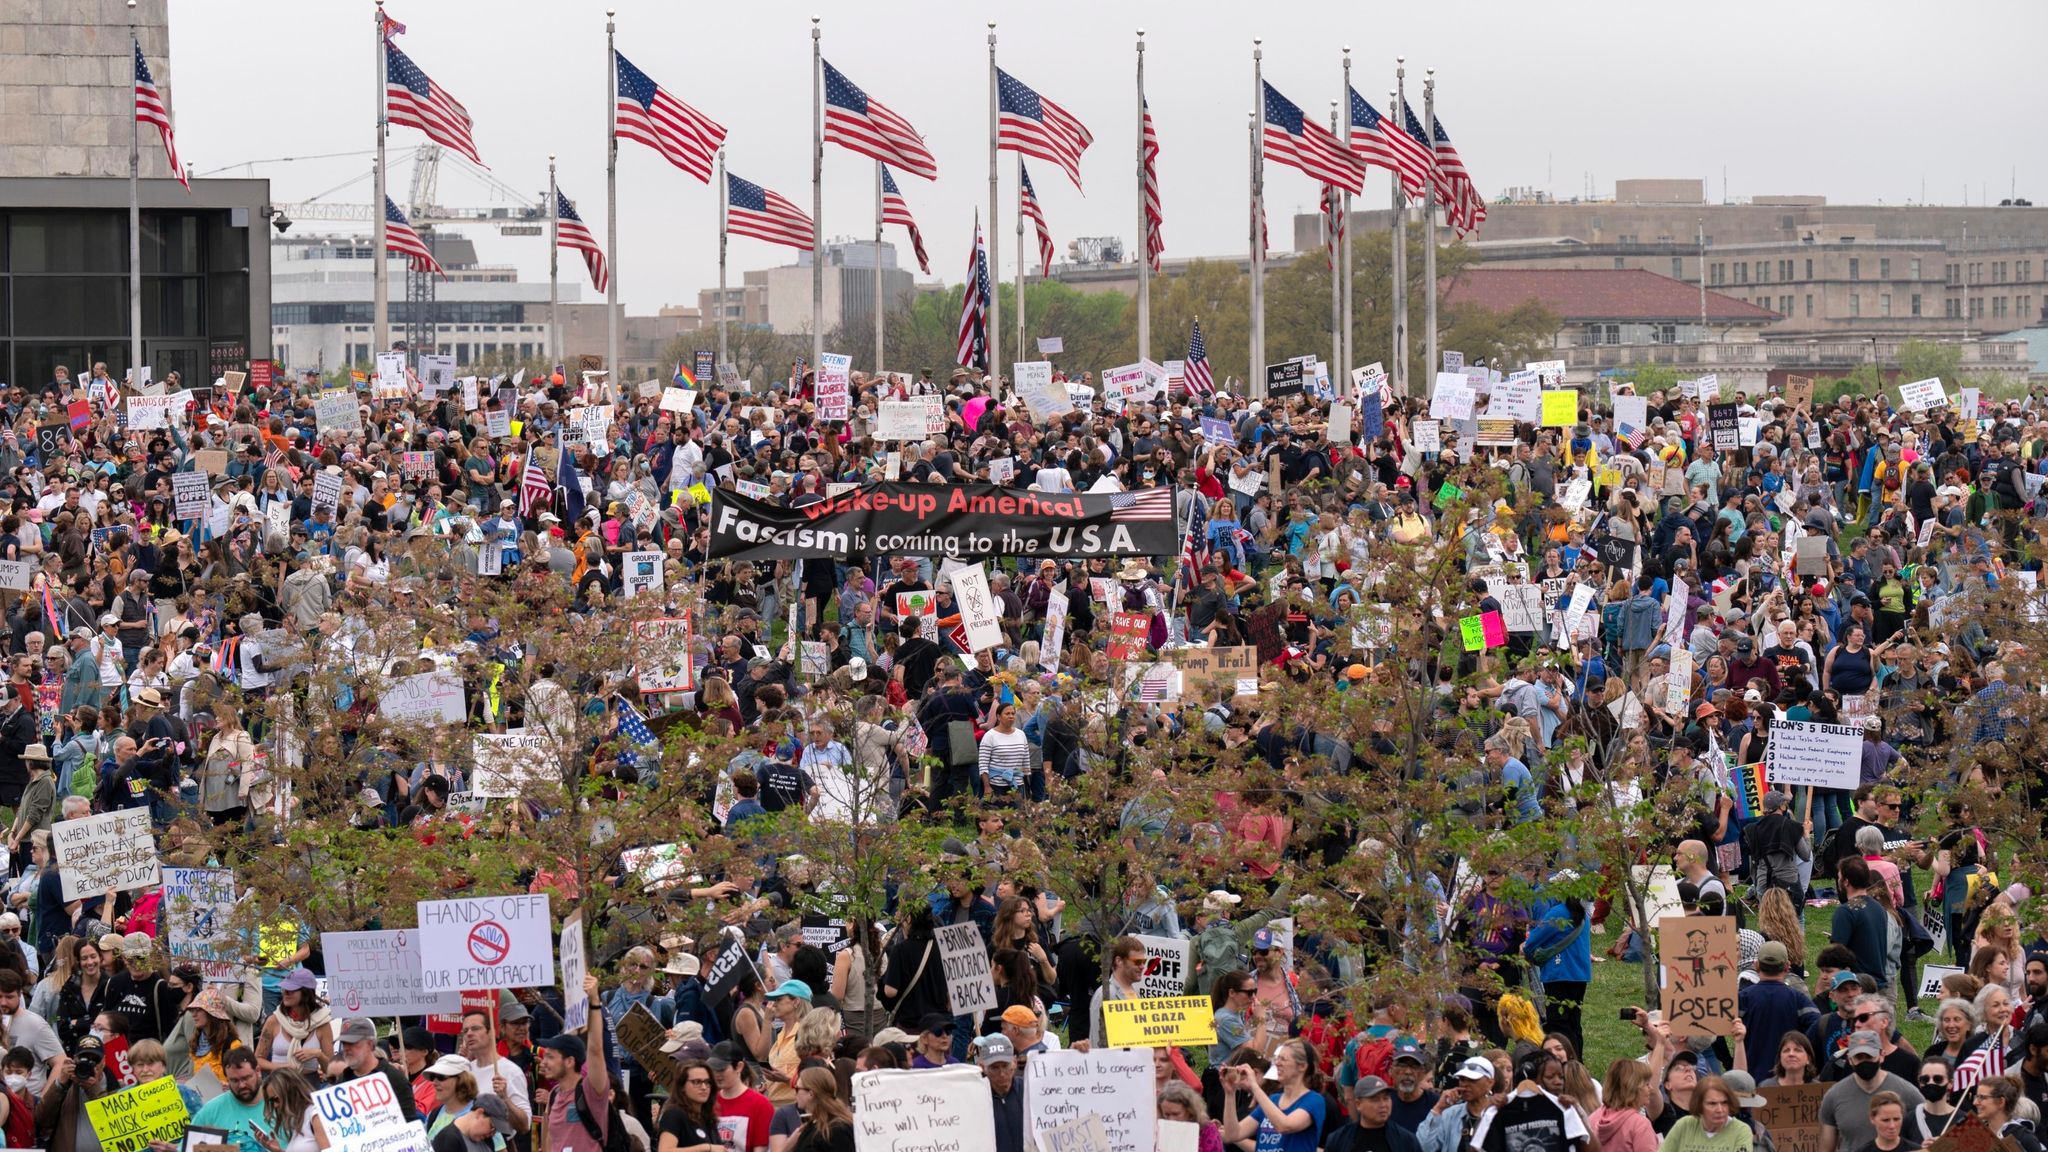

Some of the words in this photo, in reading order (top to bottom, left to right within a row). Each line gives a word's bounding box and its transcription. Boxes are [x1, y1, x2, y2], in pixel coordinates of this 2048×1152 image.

[1362, 368, 1375, 377] NO
[129, 398, 157, 407] HANDS
[159, 397, 175, 406] OFF
[1924, 398, 1945, 408] STUFF
[1713, 408, 1733, 417] 8647
[1716, 419, 1733, 428] MUSK
[1717, 434, 1734, 443] OFF!
[404, 452, 434, 462] RESIST
[178, 485, 205, 494] HANDS
[316, 484, 338, 495] HANDS
[179, 492, 207, 502] OFF!
[316, 492, 337, 504] OFF!
[802, 485, 937, 520] Wake-up
[948, 487, 1085, 517] America!
[716, 504, 848, 554] Fascism
[854, 528, 866, 551] is
[875, 528, 960, 556] coming
[968, 532, 992, 553] to
[1001, 528, 1038, 554] the
[1049, 524, 1142, 554] U.S.A.
[962, 574, 978, 588] NOT
[974, 612, 984, 621] MY
[1115, 616, 1130, 627] SAVE
[1133, 618, 1146, 629] OUR
[970, 619, 993, 631] PRESIDENT
[1211, 648, 1250, 668] Trail
[401, 700, 443, 709] SCIENCE
[1769, 720, 1804, 731] ELON'S
[1810, 724, 1815, 732] 5
[1821, 725, 1864, 736] BULLETS
[1769, 742, 1775, 750] 2
[1769, 752, 1775, 760] 3
[1769, 773, 1774, 781] 5
[1781, 774, 1800, 782] Kissed
[1814, 777, 1828, 785] ring
[1742, 768, 1761, 812] RESIST
[451, 793, 473, 806] Stand
[59, 825, 90, 844] WHEN
[97, 814, 147, 836] INJUTICE
[64, 840, 106, 862] BECOMES
[112, 834, 136, 851] LAW
[1882, 839, 1908, 851] RESIST
[77, 874, 118, 894] BECOMES
[126, 864, 155, 883] DUTY
[175, 870, 218, 885] PROTECT
[426, 900, 495, 924] HANDS
[501, 896, 544, 920] OFF
[1924, 914, 1943, 938] OFF!
[348, 938, 387, 950] PROCLAIM
[943, 926, 974, 950] BRING
[1147, 947, 1180, 959] HANDS
[337, 950, 422, 972] LIBERTY
[942, 951, 989, 981] DEMOCRACY
[1144, 956, 1180, 978] OFF
[425, 970, 450, 988] OUR
[458, 964, 543, 986] DEMOCRACY!
[1145, 978, 1184, 991] CANCER
[411, 991, 438, 1004] thereof
[956, 981, 986, 1008] BACK
[1108, 1002, 1136, 1013] FULL
[1140, 998, 1208, 1010] CEASEFIRE
[1669, 998, 1734, 1021] LOSER
[1134, 1015, 1147, 1023] IN
[1152, 1012, 1186, 1022] GAZA
[1143, 1025, 1180, 1036] NOW!
[988, 1044, 1005, 1054] DC
[1032, 1059, 1048, 1078] It
[1054, 1066, 1063, 1077] is
[1067, 1059, 1088, 1075] evil
[1096, 1063, 1107, 1074] to
[1110, 1064, 1146, 1079] conquer
[860, 1074, 880, 1089] Evil
[1040, 1086, 1062, 1096] some
[1067, 1086, 1085, 1095] one
[1091, 1083, 1116, 1094] elses
[1777, 1092, 1790, 1104] the
[1798, 1088, 1823, 1105] Peopl
[101, 1092, 138, 1116] MAGA
[317, 1078, 392, 1122] USAID
[860, 1094, 902, 1113] Trump
[916, 1094, 945, 1112] says
[1044, 1100, 1080, 1119] country
[1760, 1108, 1779, 1125] OF
[108, 1113, 141, 1136] MUSK
[141, 1099, 183, 1121] (MUSKRATS)
[862, 1120, 886, 1135] We
[896, 1115, 917, 1132] will
[929, 1114, 960, 1127] have
[1035, 1117, 1057, 1130] And
[1101, 1114, 1114, 1123] as
[1117, 1108, 1137, 1125] part
[338, 1117, 365, 1137] both
[1050, 1119, 1093, 1146] WORST
[1505, 1126, 1518, 1134] NOT
[1528, 1120, 1558, 1129] PRESIDENT
[1777, 1133, 1793, 1142] the
[1799, 1131, 1820, 1144] Peop
[116, 1138, 136, 1152] NO
[892, 1138, 960, 1152] Greenland
